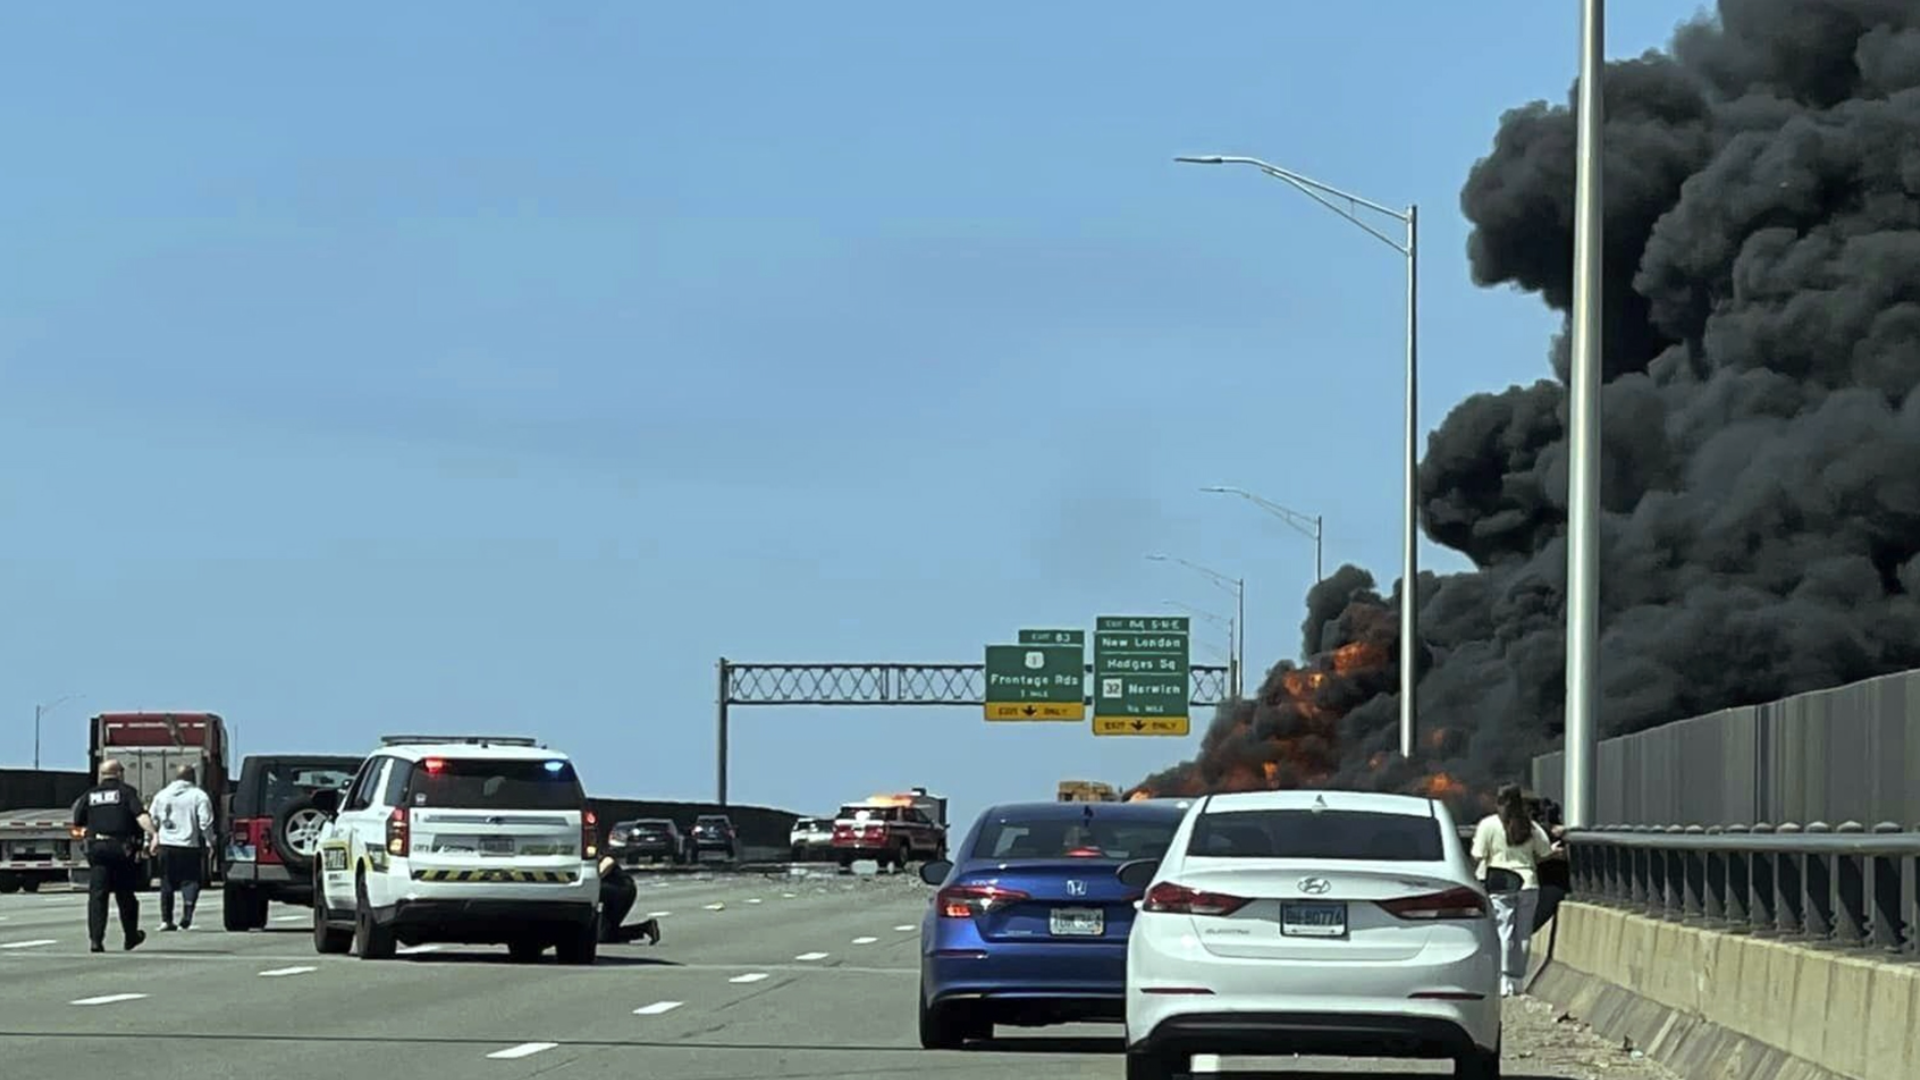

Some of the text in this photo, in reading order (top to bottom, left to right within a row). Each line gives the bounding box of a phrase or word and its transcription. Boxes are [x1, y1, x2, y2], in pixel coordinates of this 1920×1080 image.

[1055, 633, 1071, 642] 83
[1102, 637, 1181, 647] New London
[1107, 659, 1176, 670] Hodges Sq
[990, 673, 1079, 687] Frontage Rds
[1105, 683, 1181, 694] 32 Norwich
[1104, 721, 1126, 730] EXIT
